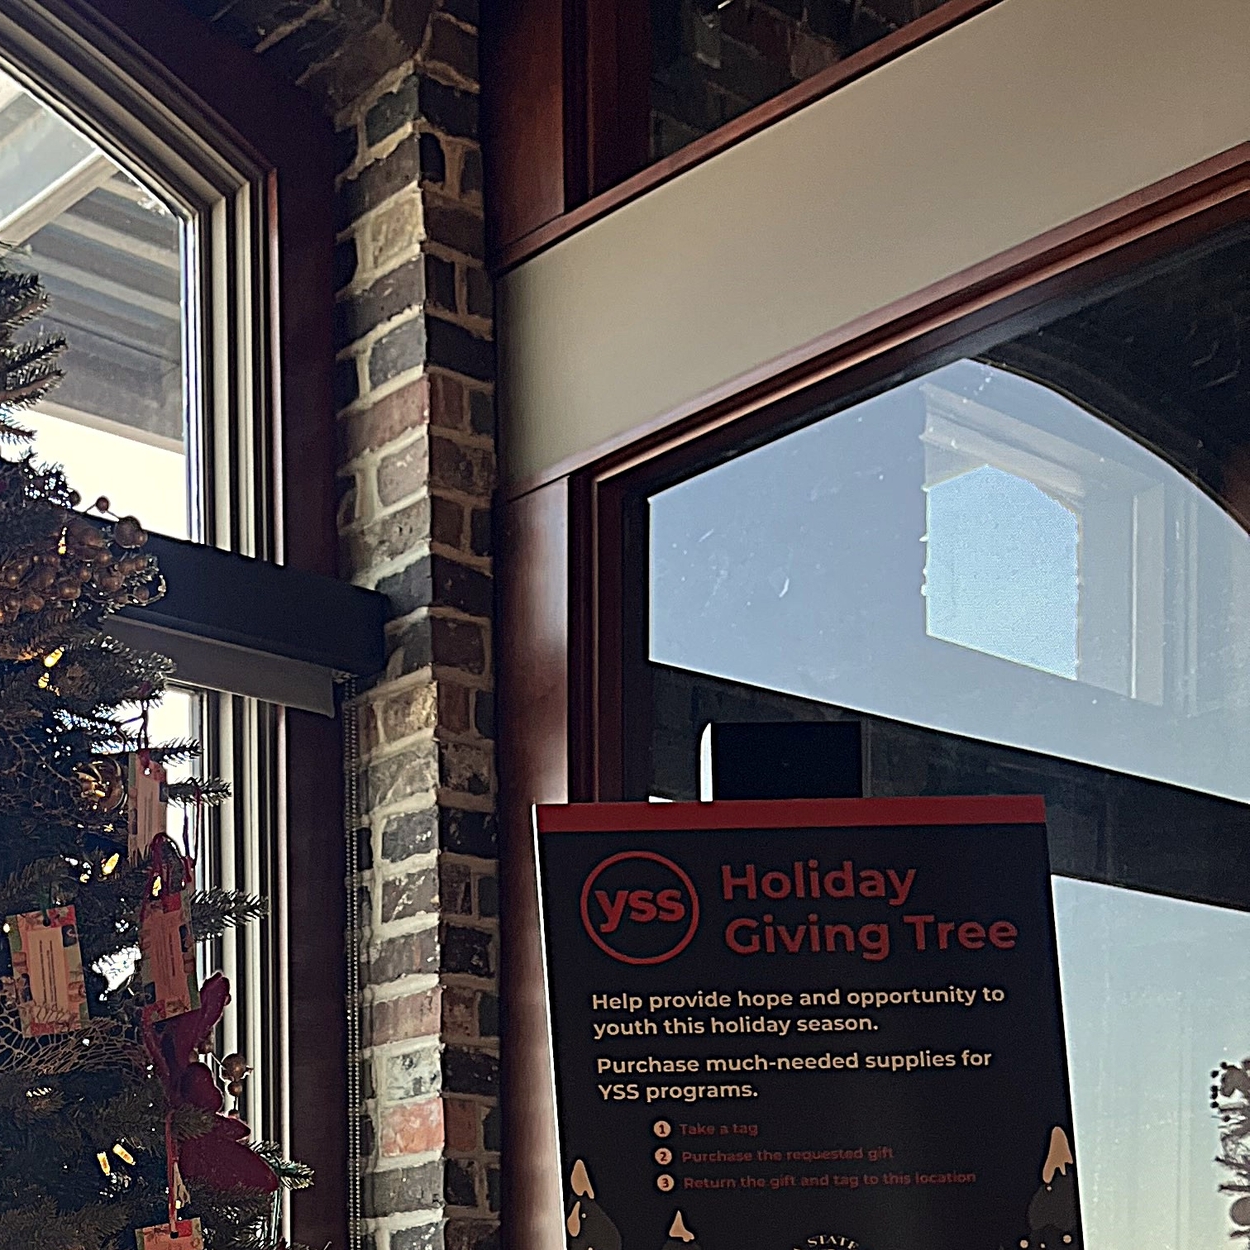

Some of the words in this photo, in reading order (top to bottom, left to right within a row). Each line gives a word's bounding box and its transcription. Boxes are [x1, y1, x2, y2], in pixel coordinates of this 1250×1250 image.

[721, 859, 917, 907] Holiday
[594, 889, 686, 934] yss
[724, 913, 890, 962] Giving
[903, 914, 1018, 950] Tree
[592, 993, 643, 1012] Help
[649, 990, 732, 1012] provide
[738, 990, 794, 1010] hope
[799, 988, 841, 1006] and
[847, 985, 977, 1008] opportunity
[982, 987, 1005, 1002] to
[593, 1018, 658, 1040] youth
[663, 1016, 705, 1035] this
[710, 1015, 791, 1036] holiday
[796, 1017, 879, 1032] season.
[597, 1056, 700, 1074] Purchase
[706, 1052, 859, 1071] much-needed
[865, 1049, 957, 1072] supplies
[961, 1049, 992, 1067] for
[598, 1084, 640, 1100] YSS
[646, 1084, 758, 1103] programs.
[679, 1122, 715, 1135] Take
[720, 1125, 729, 1135] a
[733, 1123, 758, 1137] tag
[682, 1151, 753, 1163] Purchase
[758, 1150, 782, 1161] the
[786, 1147, 863, 1163] requested
[868, 1146, 894, 1161] gift
[684, 1177, 736, 1189] Return
[740, 1175, 766, 1188] the
[770, 1173, 796, 1189] gift
[801, 1174, 829, 1187] and
[833, 1173, 859, 1188] tag
[863, 1173, 879, 1185] to
[883, 1172, 911, 1185] this
[915, 1171, 976, 1184] location
